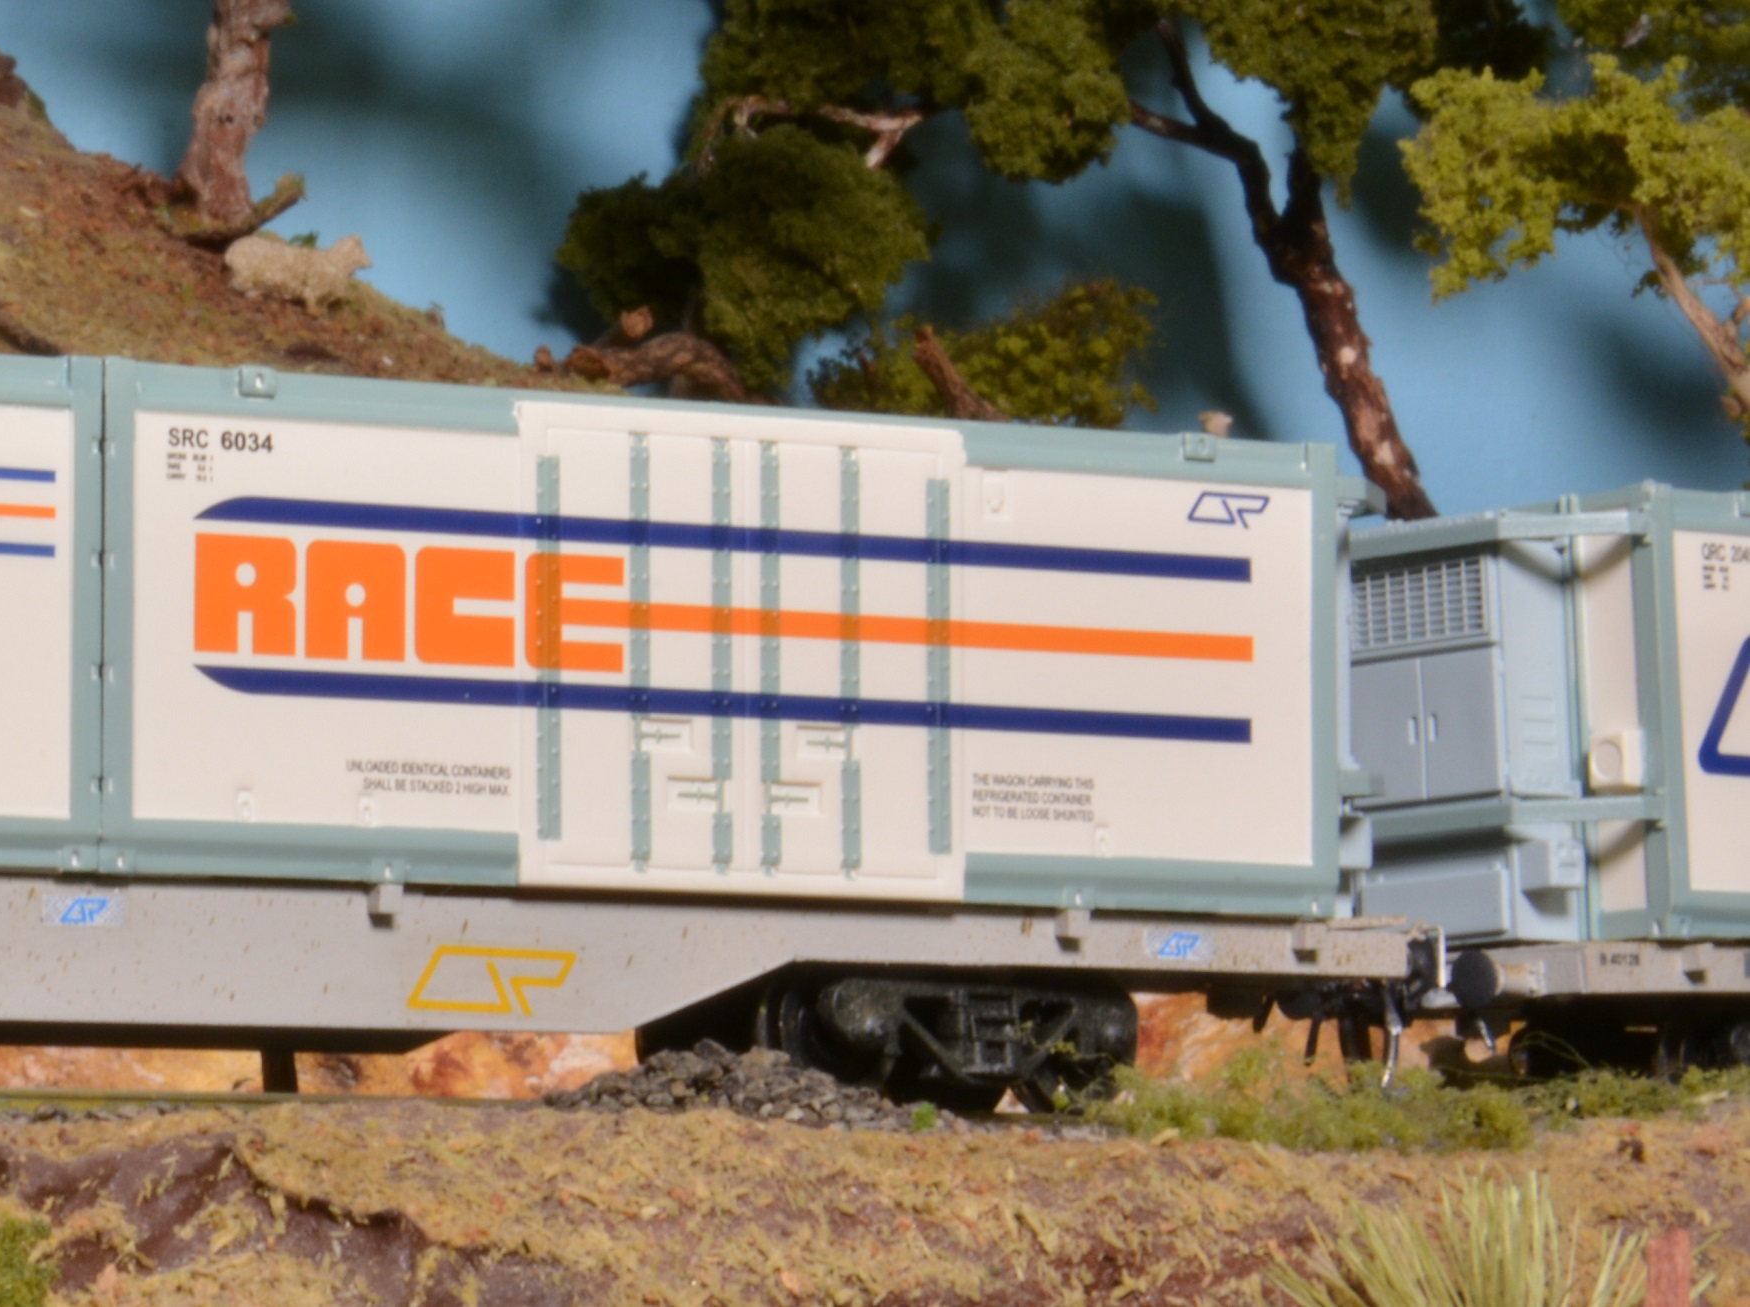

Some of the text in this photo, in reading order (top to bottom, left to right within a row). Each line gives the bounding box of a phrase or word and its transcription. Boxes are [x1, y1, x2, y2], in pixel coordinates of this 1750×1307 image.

[168, 427, 273, 453] SRC 6034
[194, 533, 625, 673] RACE
[346, 759, 512, 780] UNLOADED IDENTICAL CONTAINERS
[363, 777, 392, 791] SHALL
[395, 778, 406, 791] BE
[410, 779, 453, 793] STACKED
[455, 781, 461, 795] 2
[463, 782, 486, 795] HIGH
[973, 773, 1095, 790] THE WAGON CARRYING THIS
[972, 788, 1092, 806] REFRIGERATED CONTAINER
[972, 805, 1094, 822] NOT TO BE LOOSE SHUNTED
